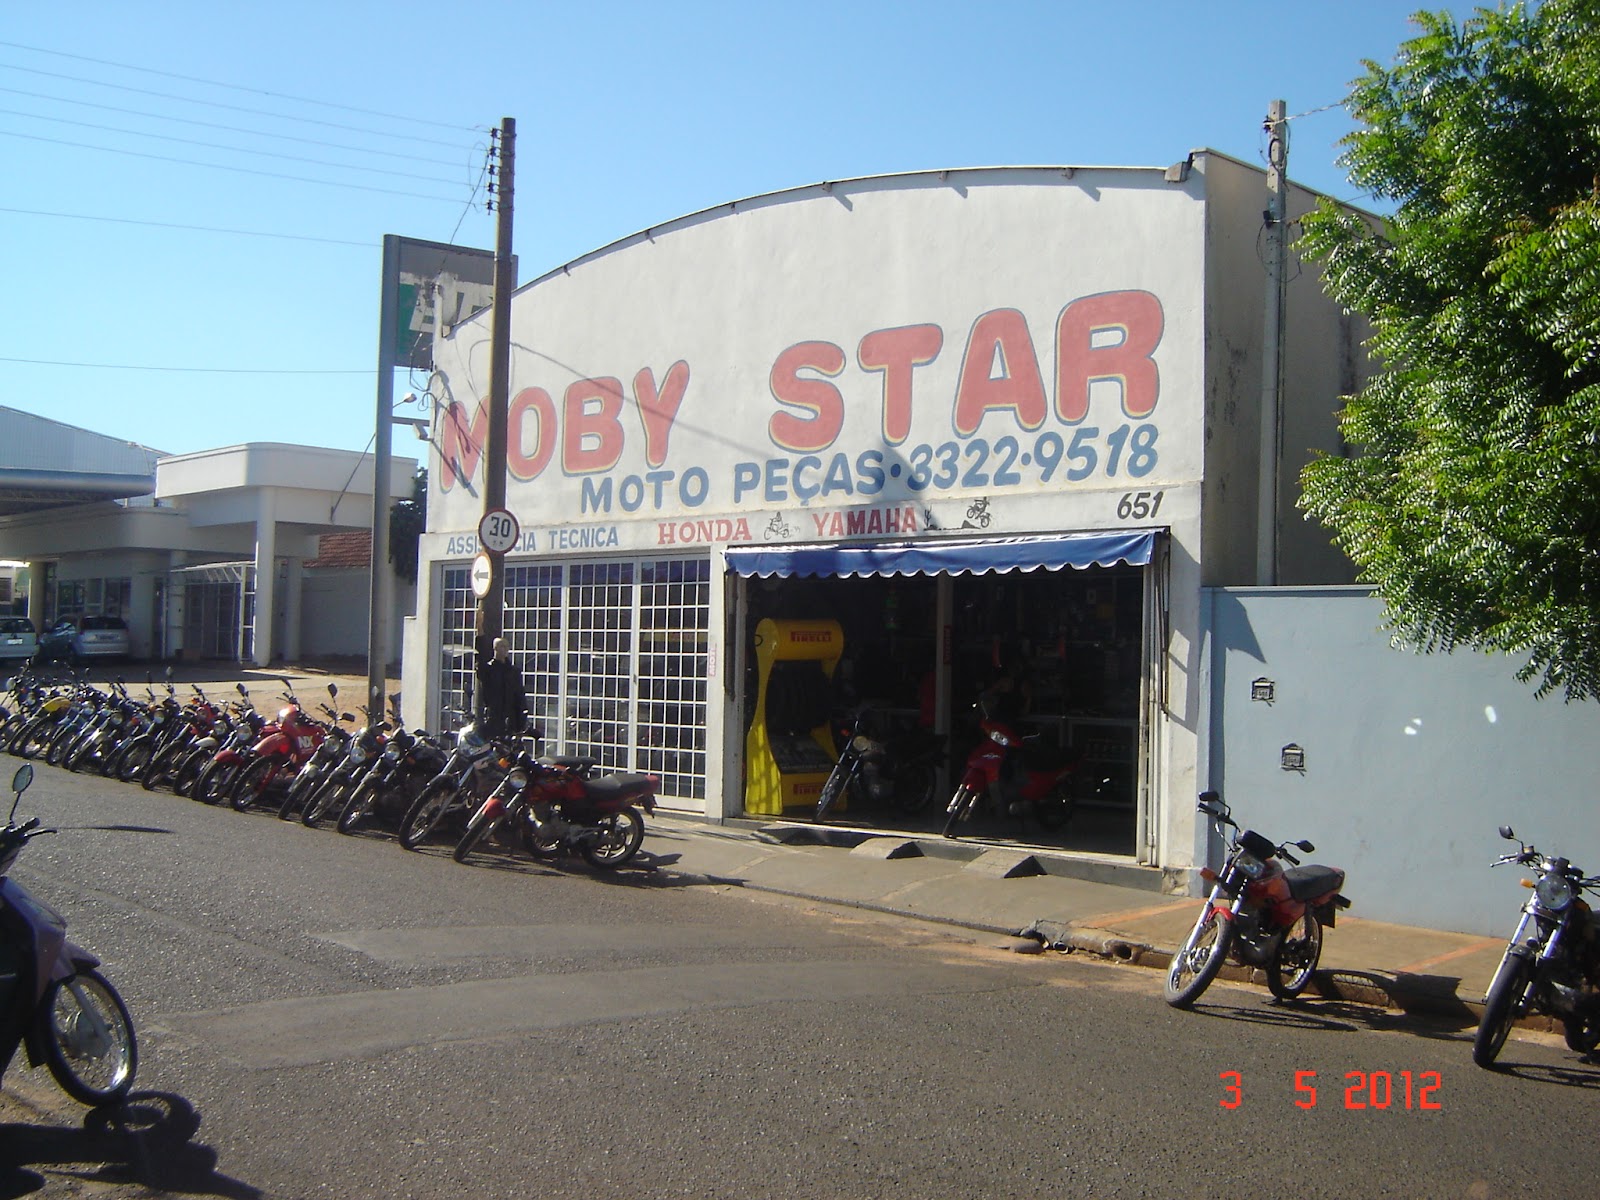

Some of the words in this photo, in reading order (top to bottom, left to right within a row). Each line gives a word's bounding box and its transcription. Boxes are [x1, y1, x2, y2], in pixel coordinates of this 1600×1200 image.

[440, 360, 690, 494] MOBY
[768, 289, 1165, 454] STAR
[581, 467, 709, 513] MOTO
[734, 450, 885, 506] PEÇAS
[1117, 491, 1164, 519] 651
[489, 516, 511, 538] 30
[549, 526, 619, 549] TECNICA
[658, 518, 752, 544] HONDA
[812, 507, 917, 537] YAMAHA
[791, 631, 832, 642] PIRELLI
[297, 735, 314, 749] NX
